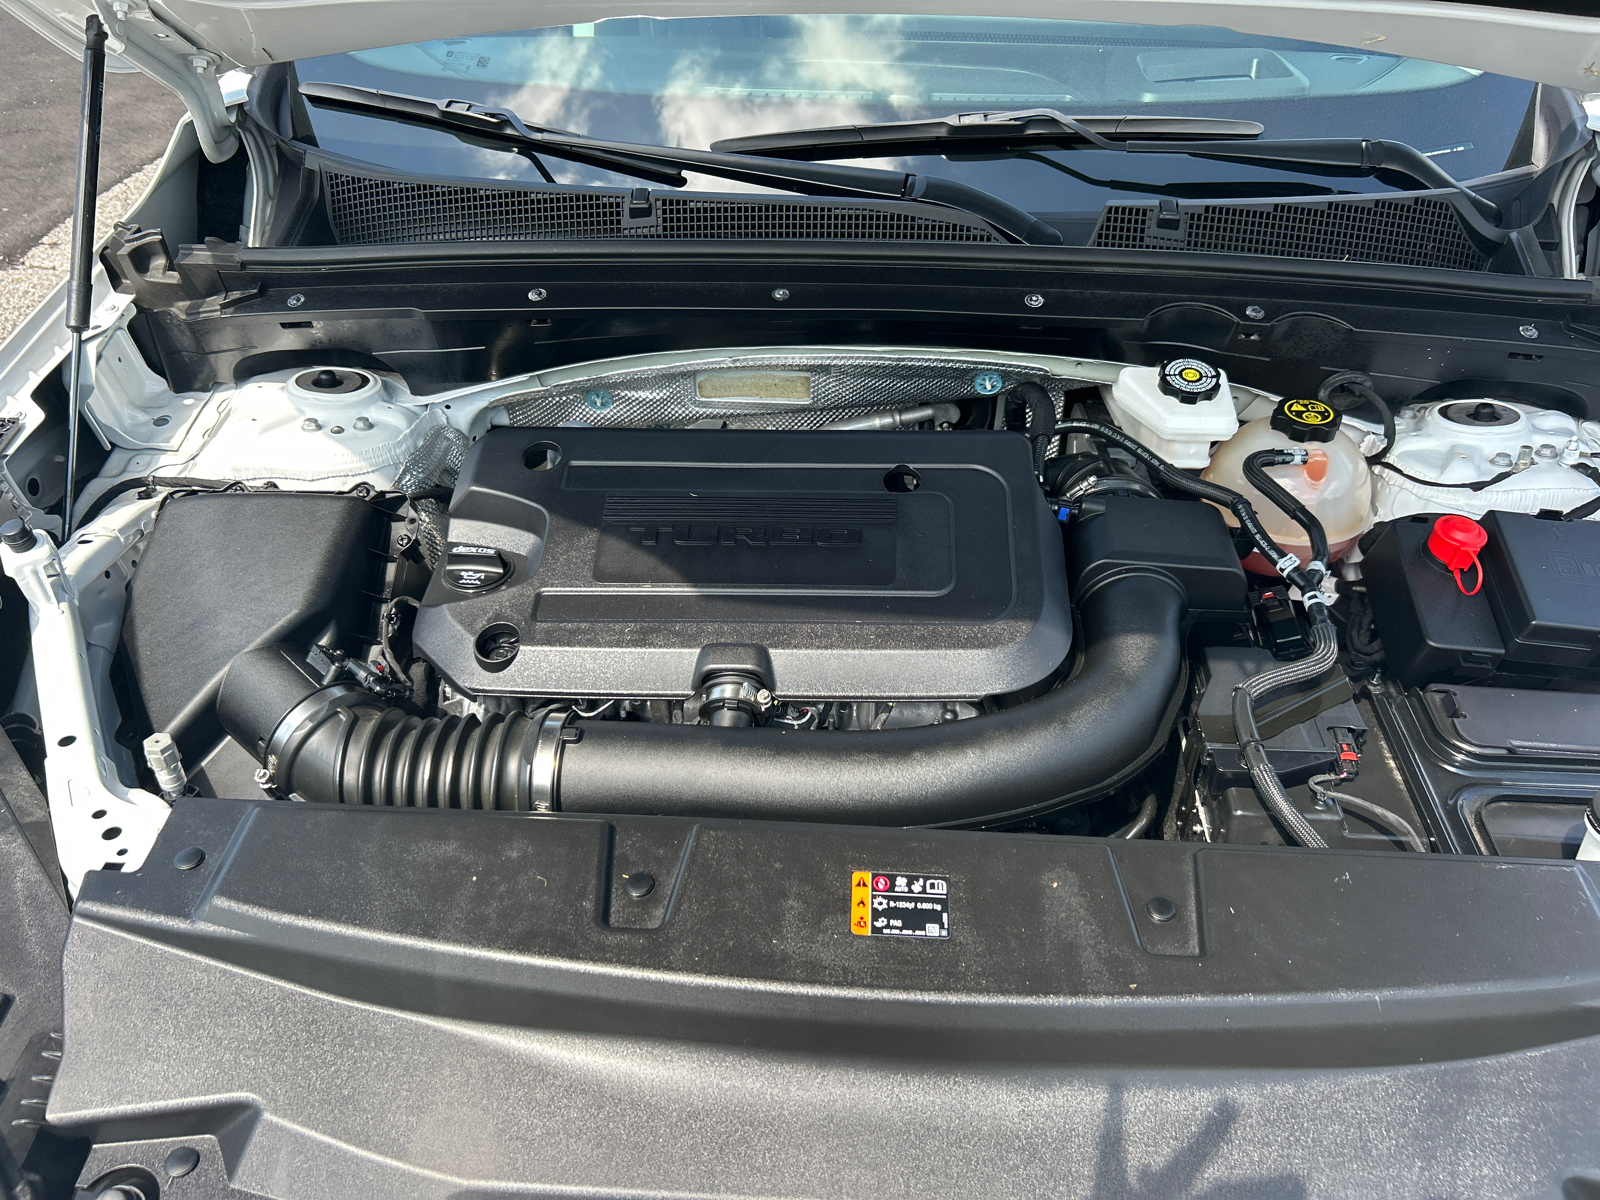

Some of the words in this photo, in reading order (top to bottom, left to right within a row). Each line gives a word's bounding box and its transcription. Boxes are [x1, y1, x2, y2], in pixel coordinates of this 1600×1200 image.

[629, 525, 861, 547] TURBO
[452, 545, 497, 554] dexos
[934, 903, 941, 911] kg
